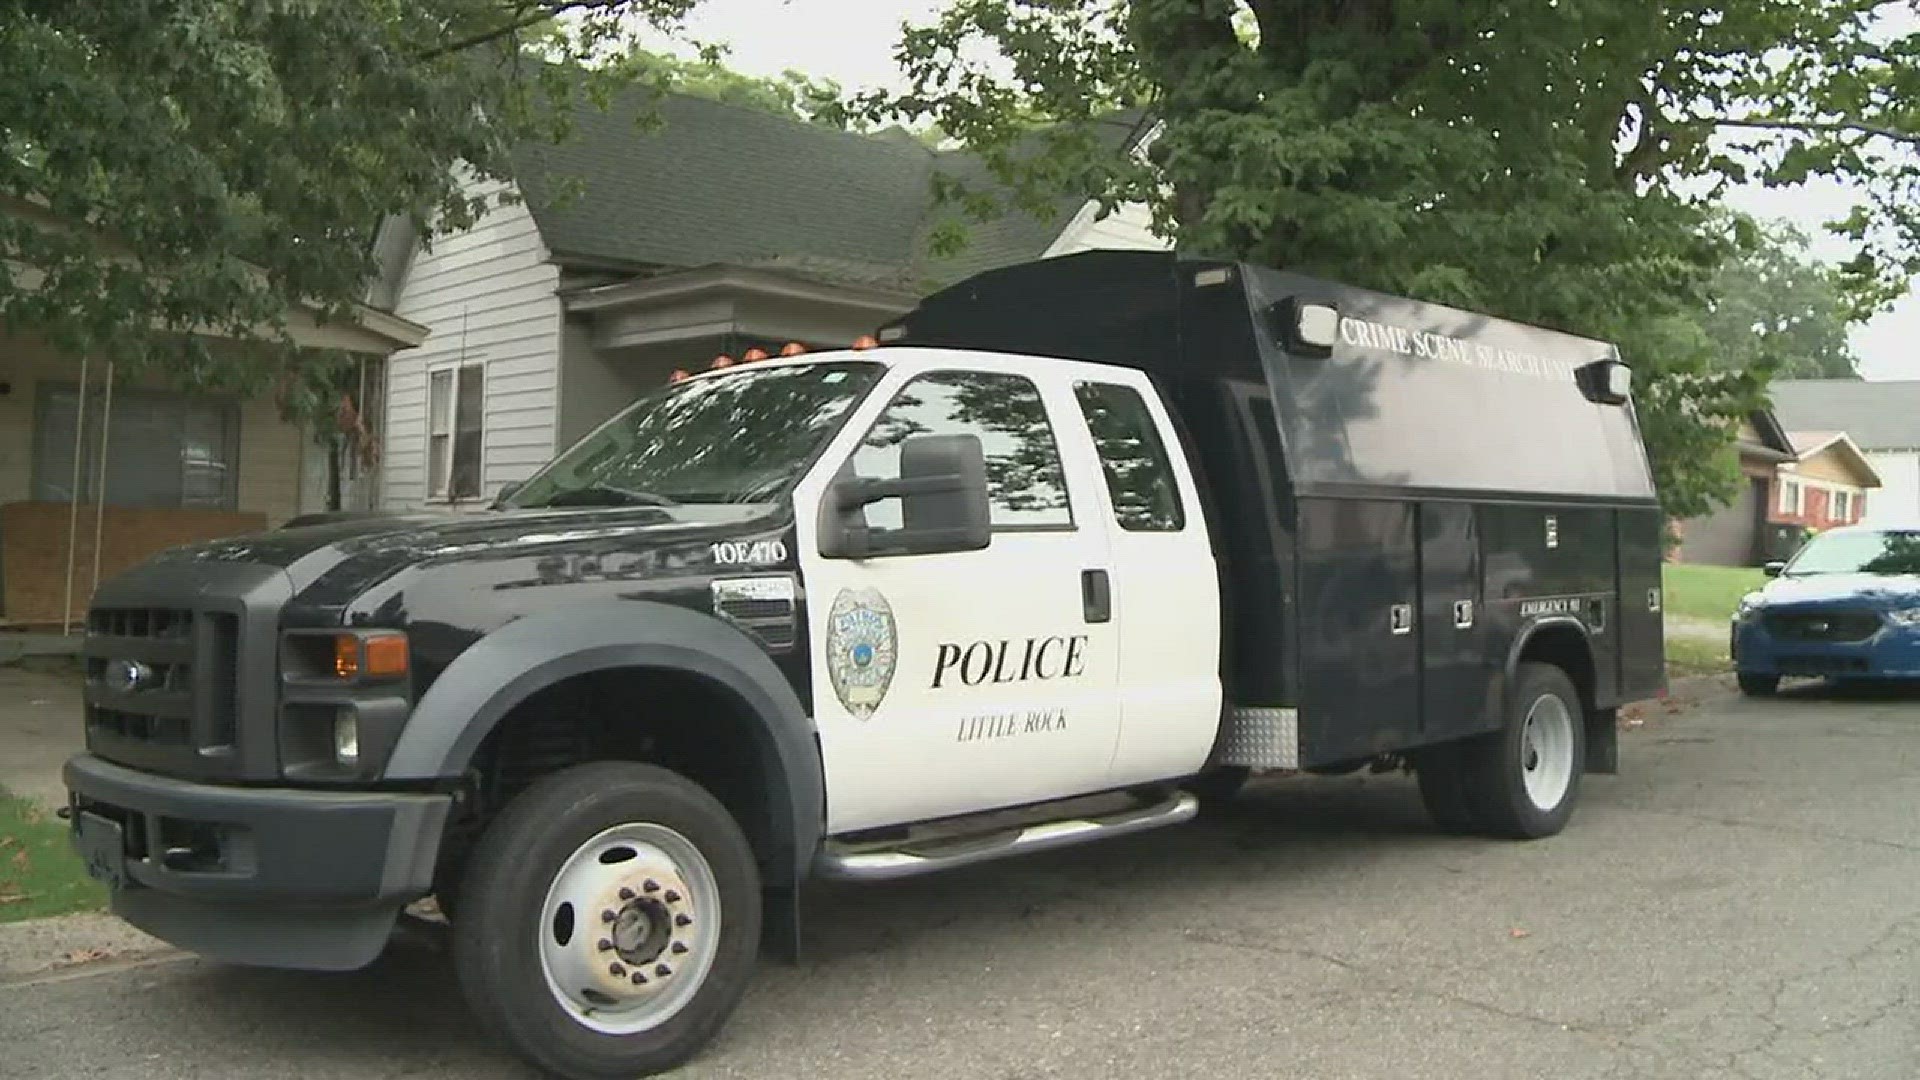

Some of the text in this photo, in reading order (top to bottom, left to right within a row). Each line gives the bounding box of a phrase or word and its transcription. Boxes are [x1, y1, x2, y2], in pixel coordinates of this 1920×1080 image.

[1340, 317, 1410, 354] CRIME
[1412, 331, 1473, 363] SCENE
[711, 541, 788, 564] 10E470
[930, 635, 1089, 688] POLICE
[957, 709, 1067, 742] LITTLE ROCK
